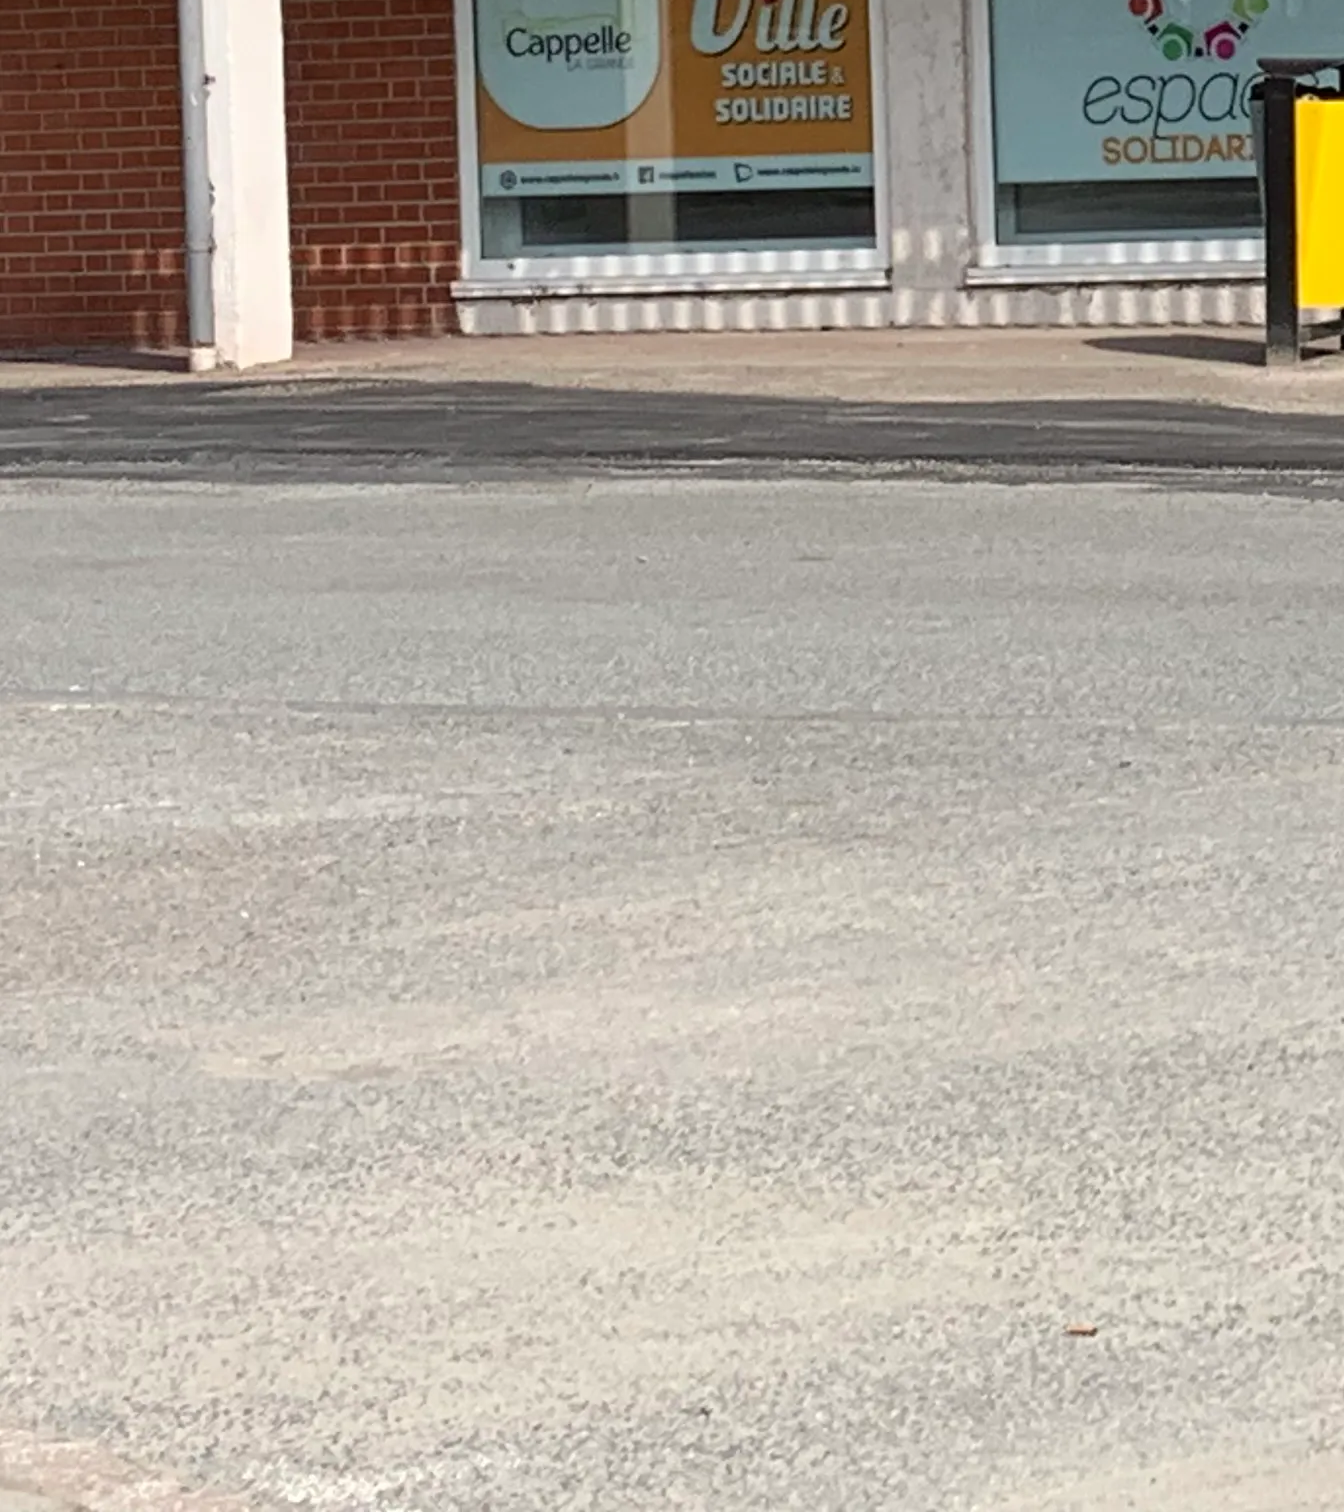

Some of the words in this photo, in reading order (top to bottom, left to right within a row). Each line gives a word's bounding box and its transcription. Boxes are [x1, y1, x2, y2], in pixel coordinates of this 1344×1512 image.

[506, 25, 632, 62] Cappelle
[721, 60, 828, 89] SOCIALE
[830, 66, 845, 85] &
[715, 95, 853, 125] SOLIDAIRE
[1083, 71, 1321, 139] espac
[1103, 134, 1257, 166] SOLIDAR
